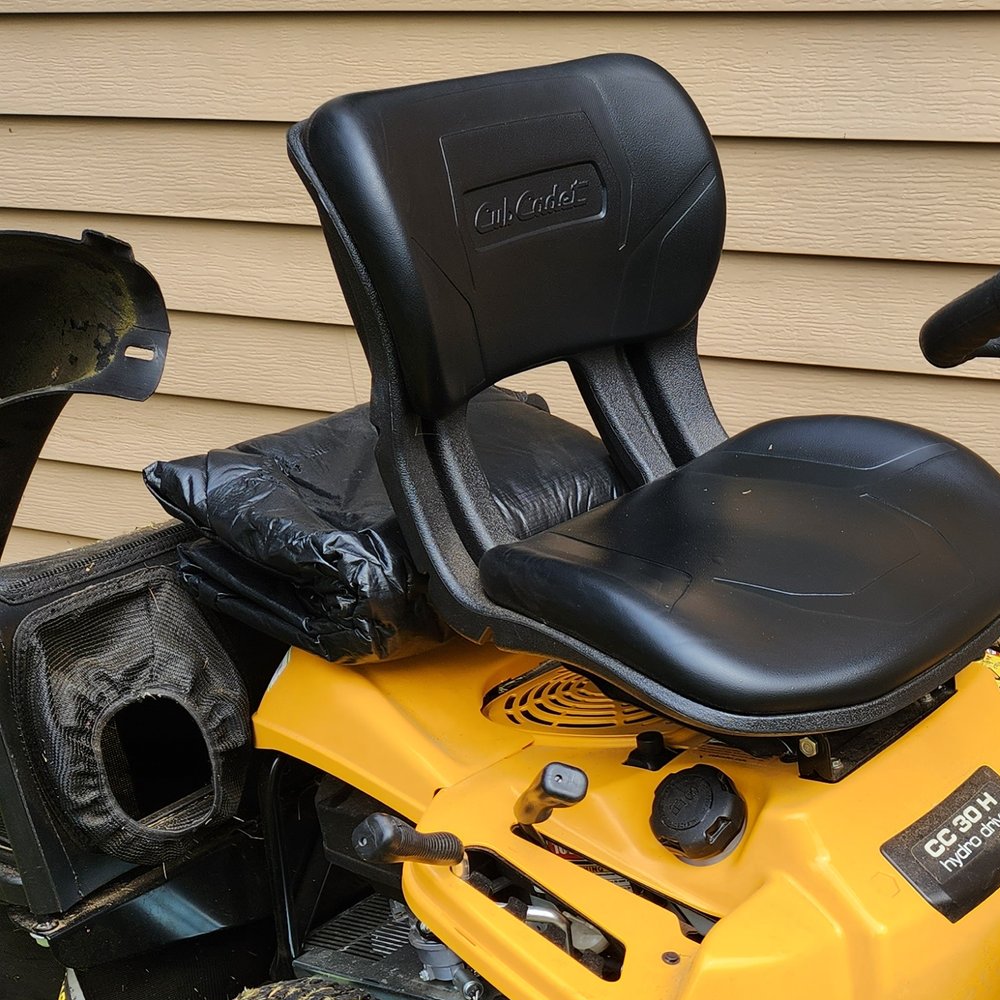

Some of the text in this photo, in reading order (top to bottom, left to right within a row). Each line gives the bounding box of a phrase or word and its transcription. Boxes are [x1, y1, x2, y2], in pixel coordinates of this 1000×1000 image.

[474, 179, 589, 234] Cub Cadet
[924, 791, 998, 858] CC 30 H
[939, 835, 982, 872] hydro
